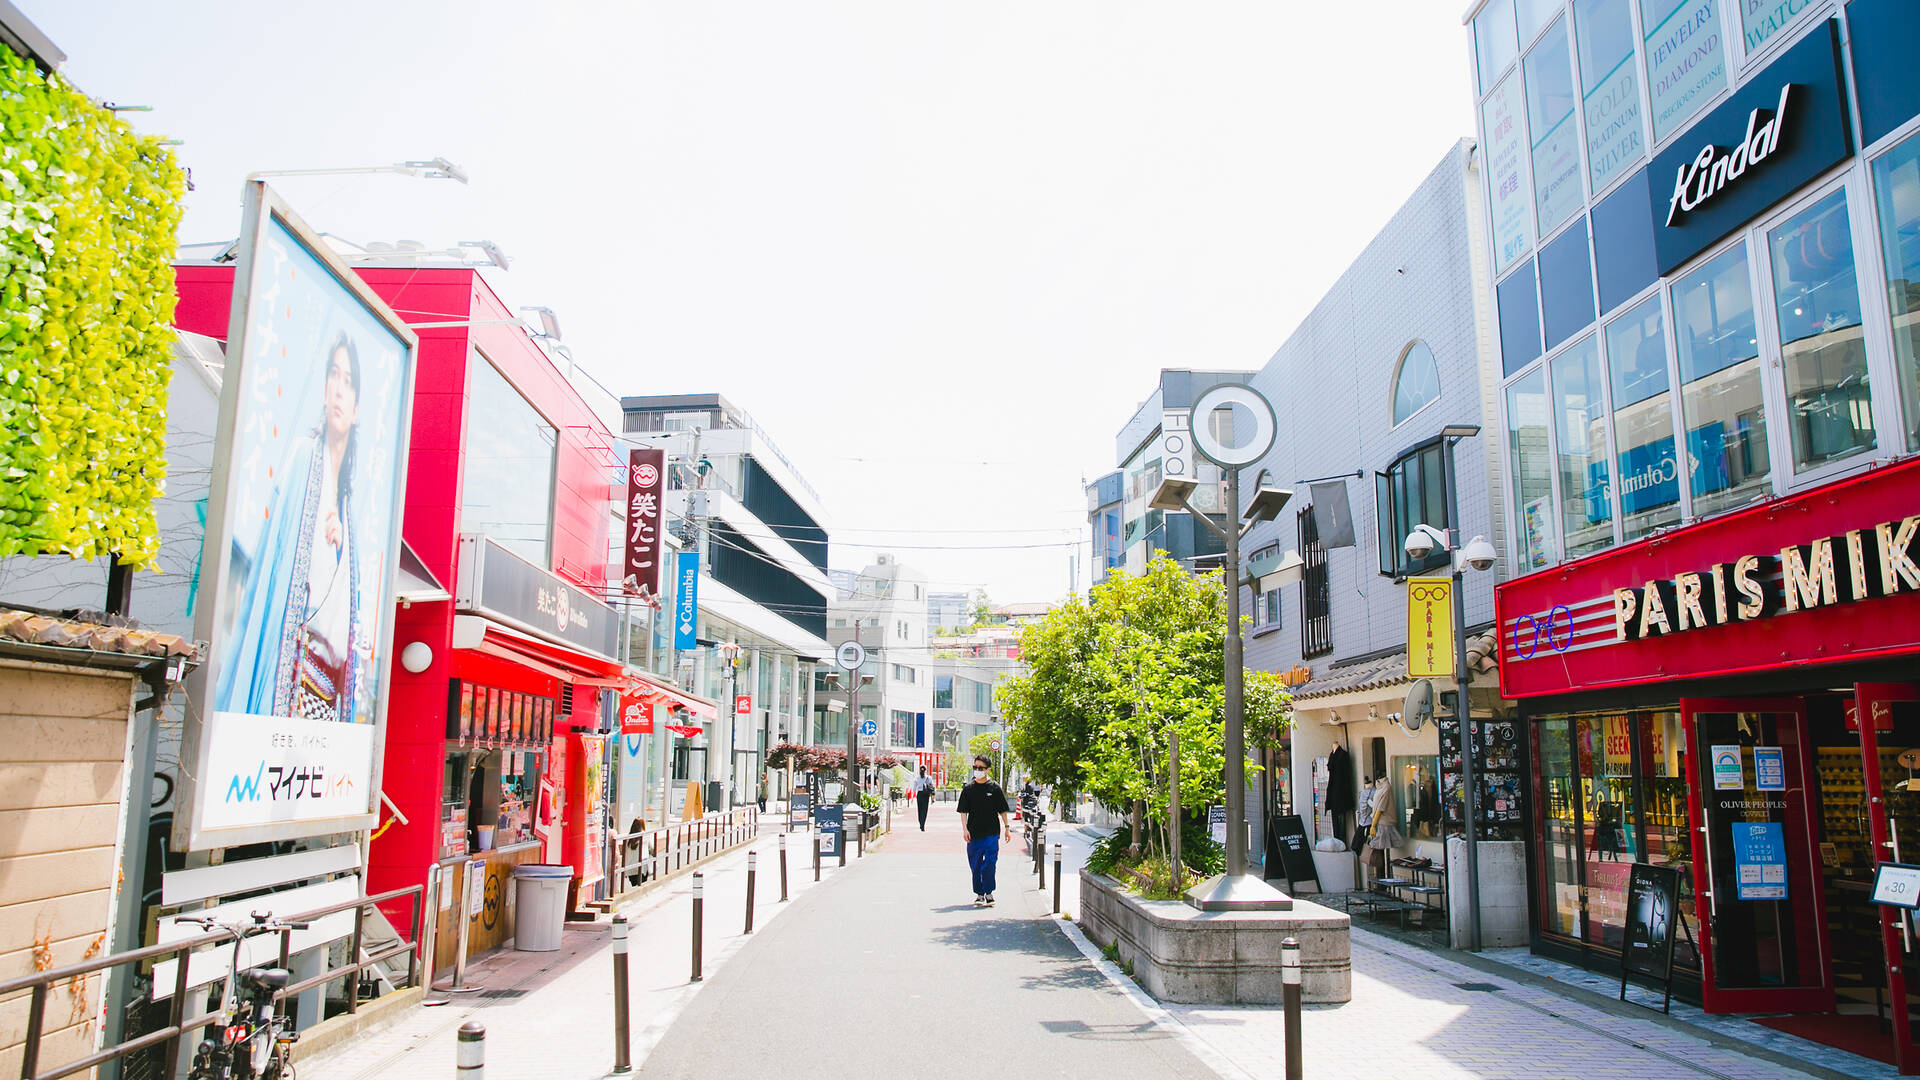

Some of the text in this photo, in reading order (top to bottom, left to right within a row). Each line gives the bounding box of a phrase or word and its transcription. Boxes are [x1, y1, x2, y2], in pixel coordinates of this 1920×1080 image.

[1653, 1, 1713, 71] JEWELRY
[1747, 0, 1814, 49] WATC
[1655, 33, 1719, 98] DIAMOND
[1589, 75, 1633, 128] GOLD
[1658, 64, 1724, 124] PRECIOUS STONE
[1589, 104, 1638, 154] PLATINUM
[1594, 130, 1641, 181] SILVER
[1665, 82, 1791, 228] Kindal
[631, 492, 657, 568] 笑たこ
[536, 586, 557, 617] 笑たこ
[680, 569, 694, 623] Columbia
[1613, 513, 1920, 642] PARIS MIK
[1426, 642, 1435, 672] MIKI
[1720, 800, 1788, 809] OLIVER PEOPLES
